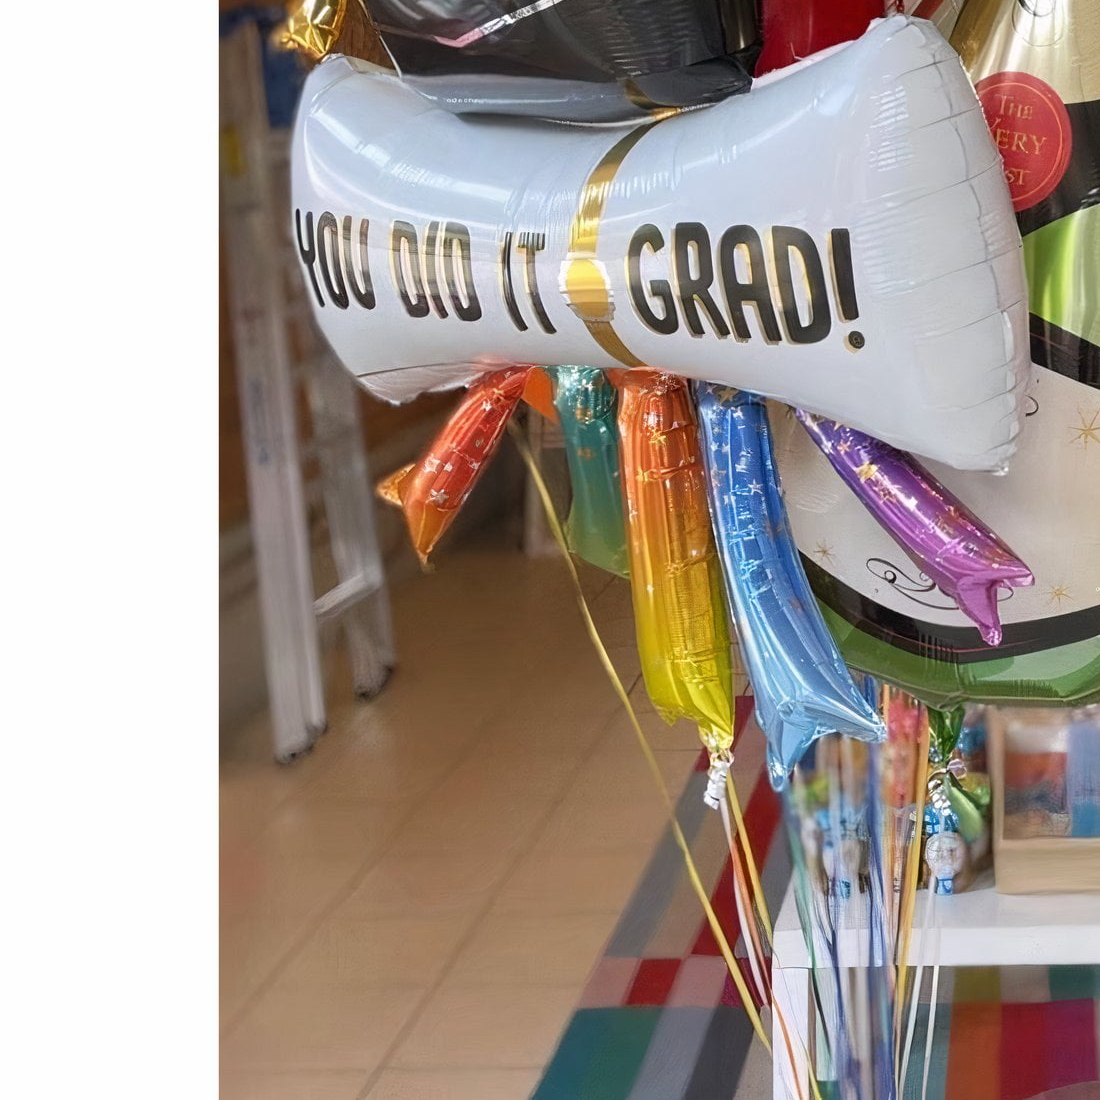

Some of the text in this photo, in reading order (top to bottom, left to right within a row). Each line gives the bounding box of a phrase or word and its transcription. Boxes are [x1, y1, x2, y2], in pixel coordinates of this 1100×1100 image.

[1004, 168, 1031, 186] ST
[295, 207, 866, 353] YOU DID IT GRAD!
